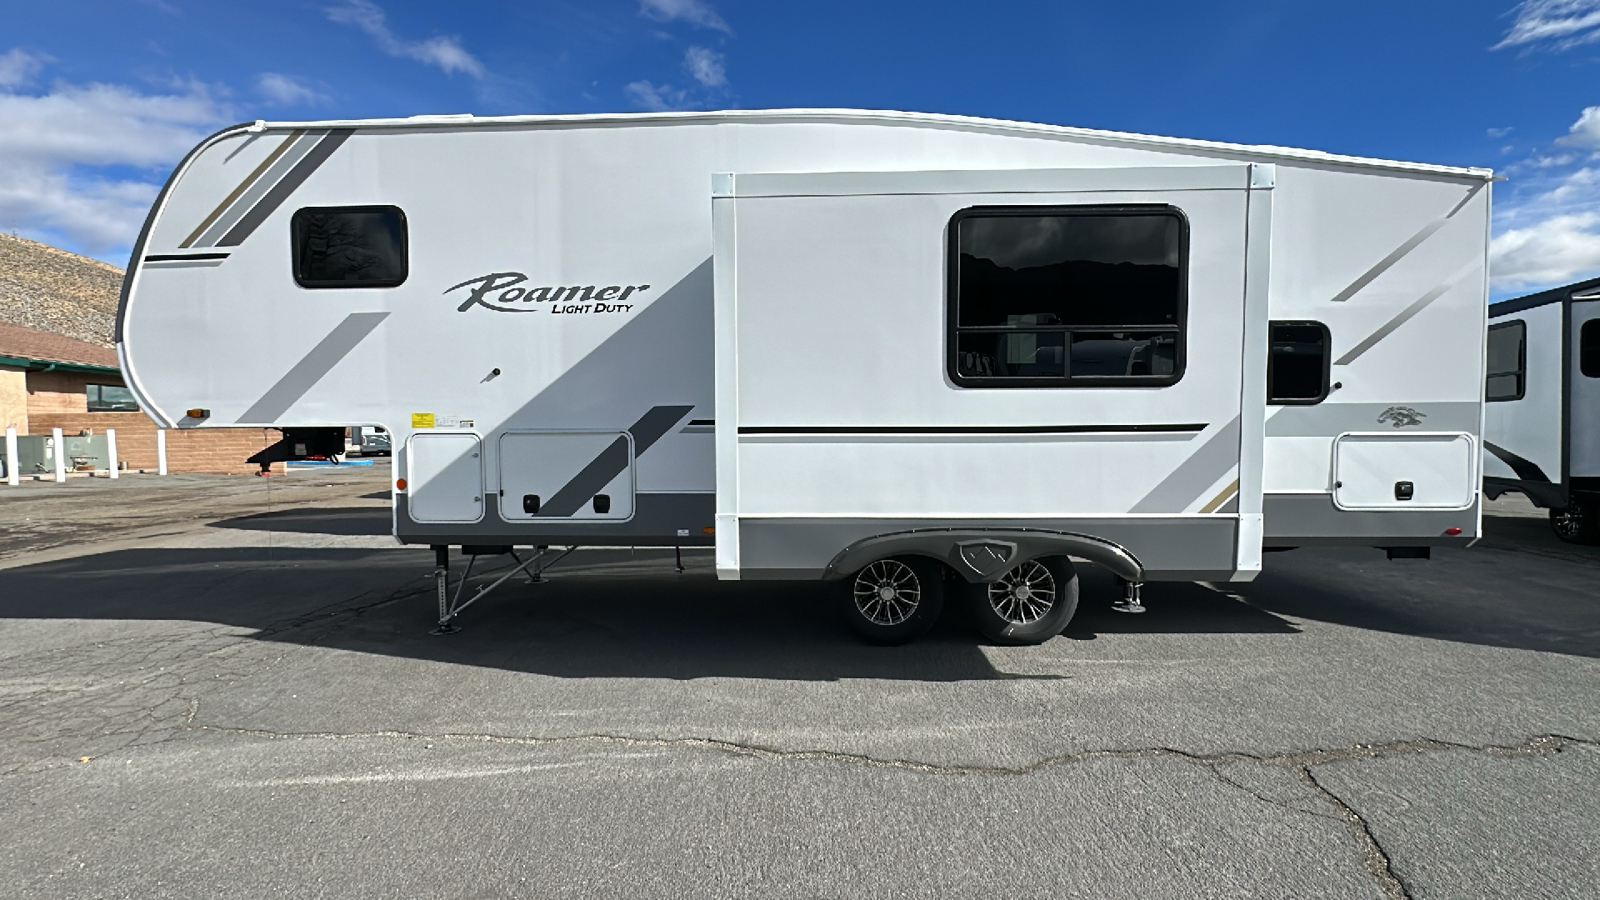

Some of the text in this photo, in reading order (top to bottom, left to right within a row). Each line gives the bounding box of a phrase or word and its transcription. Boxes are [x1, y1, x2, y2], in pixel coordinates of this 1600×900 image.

[442, 272, 650, 313] Roamer
[551, 303, 634, 314] LIGHT DUTY
